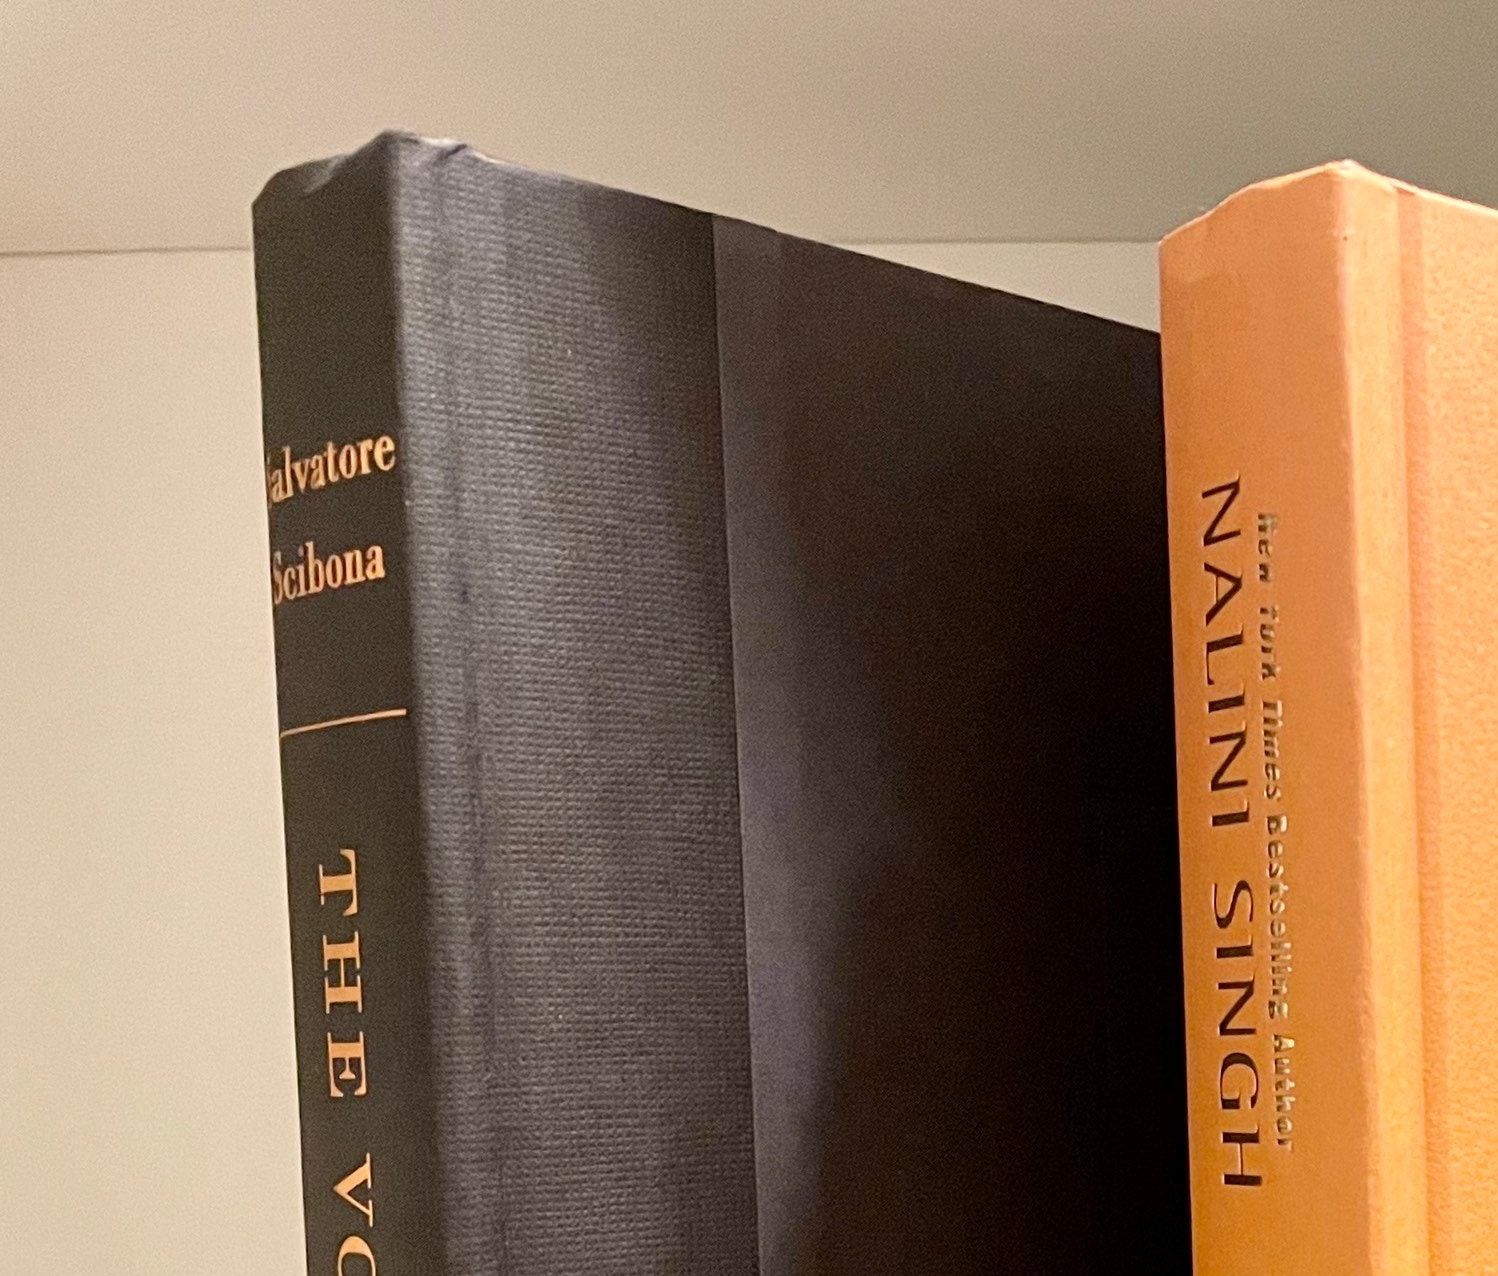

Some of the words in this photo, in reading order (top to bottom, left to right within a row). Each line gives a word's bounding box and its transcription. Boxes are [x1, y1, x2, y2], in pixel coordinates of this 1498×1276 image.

[267, 435, 396, 508] alvatore
[1201, 470, 1250, 828] NALINI
[1262, 700, 1283, 803] Times
[318, 848, 368, 1098] THE
[1266, 814, 1293, 1021] Bestselling
[1211, 879, 1264, 1188] SINGH
[1273, 1033, 1296, 1156] Author
